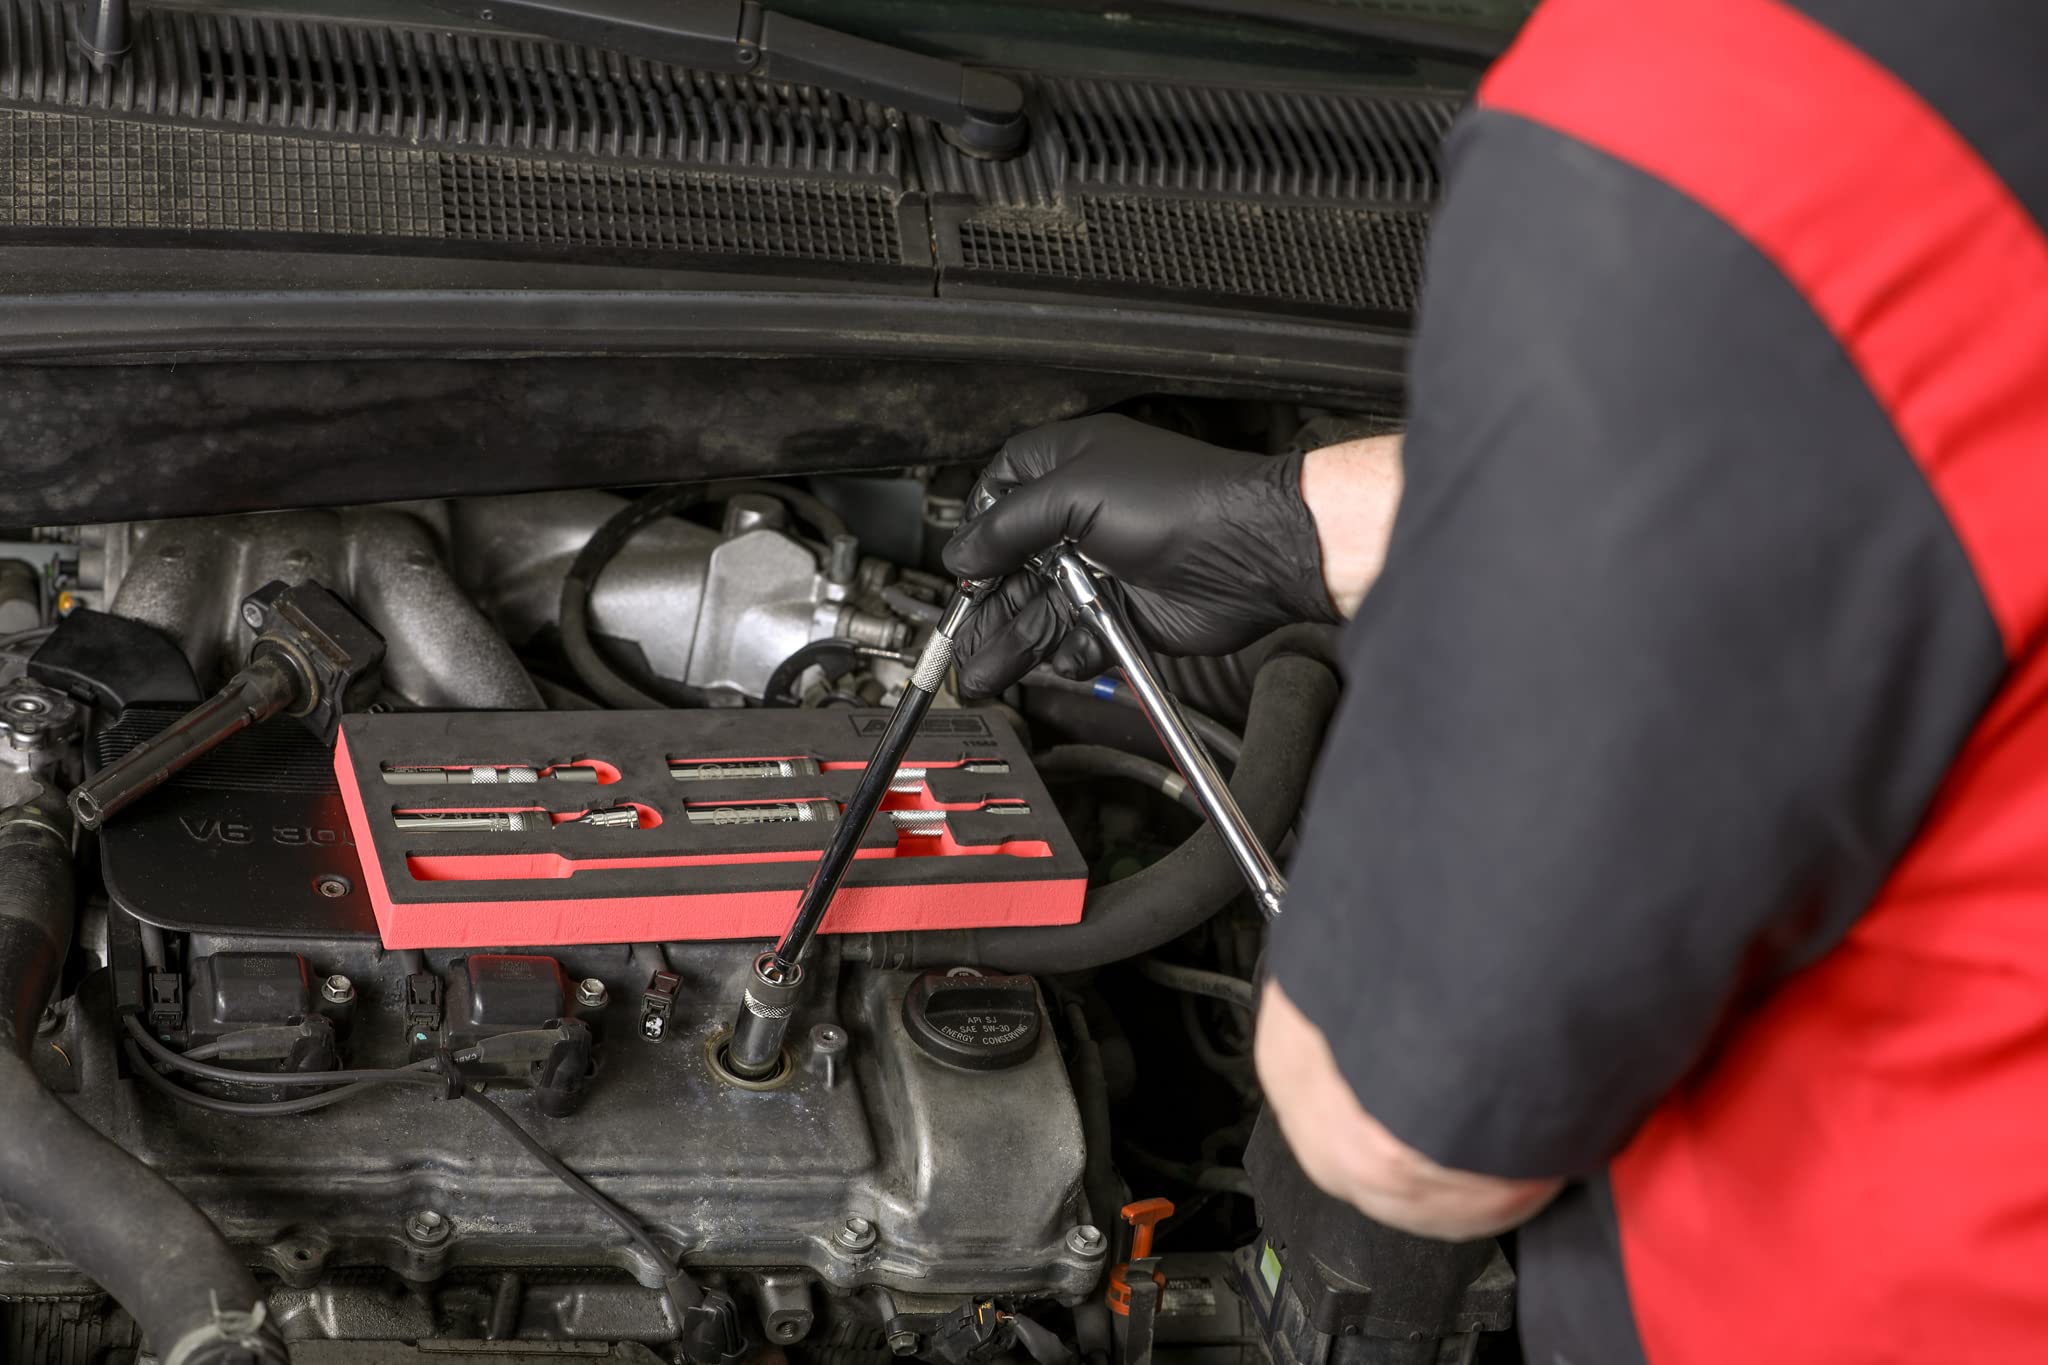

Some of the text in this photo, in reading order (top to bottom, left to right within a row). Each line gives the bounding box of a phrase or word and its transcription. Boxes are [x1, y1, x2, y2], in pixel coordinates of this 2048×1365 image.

[863, 719, 982, 732] AES
[178, 816, 254, 845] V6
[967, 1016, 997, 1024] API SJ
[941, 1023, 1028, 1046] ENERGY CONSERVING
[959, 1024, 1011, 1034] SAE 5W-30
[454, 1052, 477, 1063] CABL
